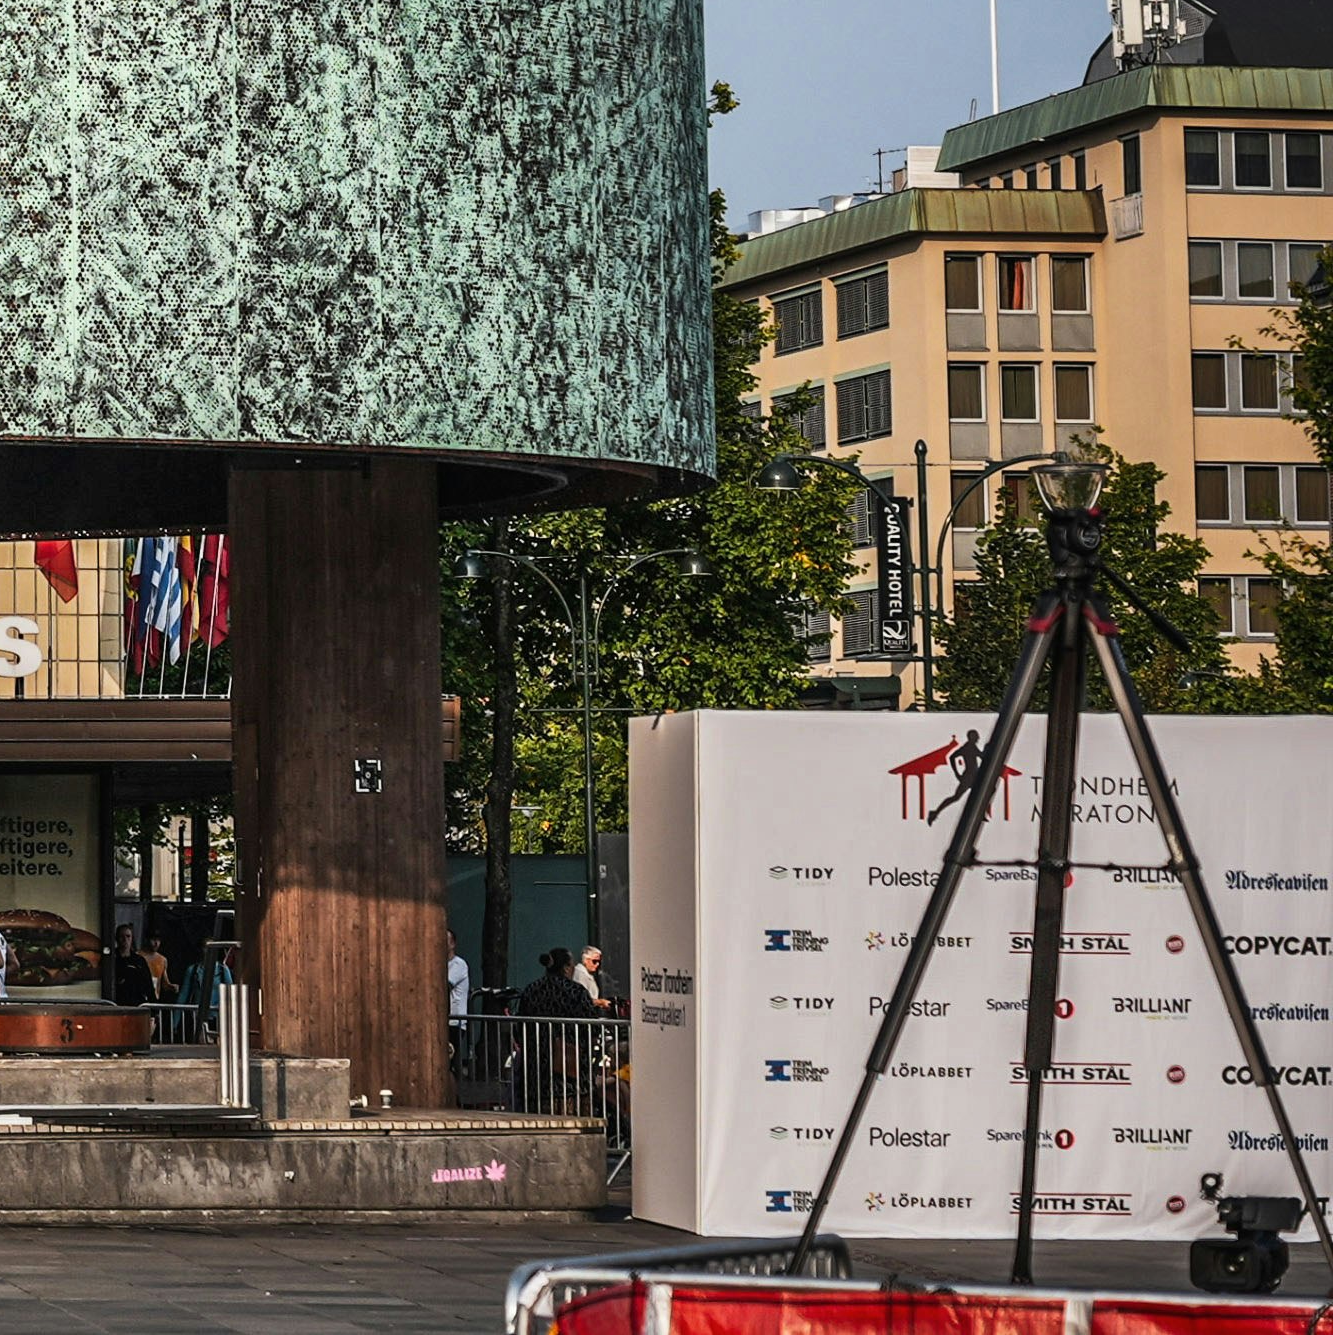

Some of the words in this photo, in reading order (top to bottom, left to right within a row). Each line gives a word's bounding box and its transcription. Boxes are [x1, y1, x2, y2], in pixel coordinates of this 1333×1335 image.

[888, 569, 903, 617] HOTEL
[1031, 804, 1155, 824] MRATON
[792, 867, 834, 879] TIDY
[869, 867, 941, 886] Polesta
[985, 869, 1038, 882] SpareBa
[1113, 868, 1182, 883] BRILLIAN
[1082, 936, 1129, 950] STÅL
[792, 997, 834, 1009] TIDY
[1112, 997, 1192, 1013] BRILLIANT
[61, 1019, 74, 1044] 3
[891, 1062, 974, 1078] LÖPLABBET
[1012, 1067, 1074, 1080] SITH
[1082, 1066, 1130, 1080] STÅL
[793, 1128, 835, 1140] TIDY
[869, 1127, 951, 1147] Polestar
[1112, 1128, 1193, 1144] BRILLIANT
[1228, 1130, 1329, 1152] Adressevisen
[891, 1193, 973, 1208] LÖPLABBET
[1083, 1196, 1130, 1211] STÅL
